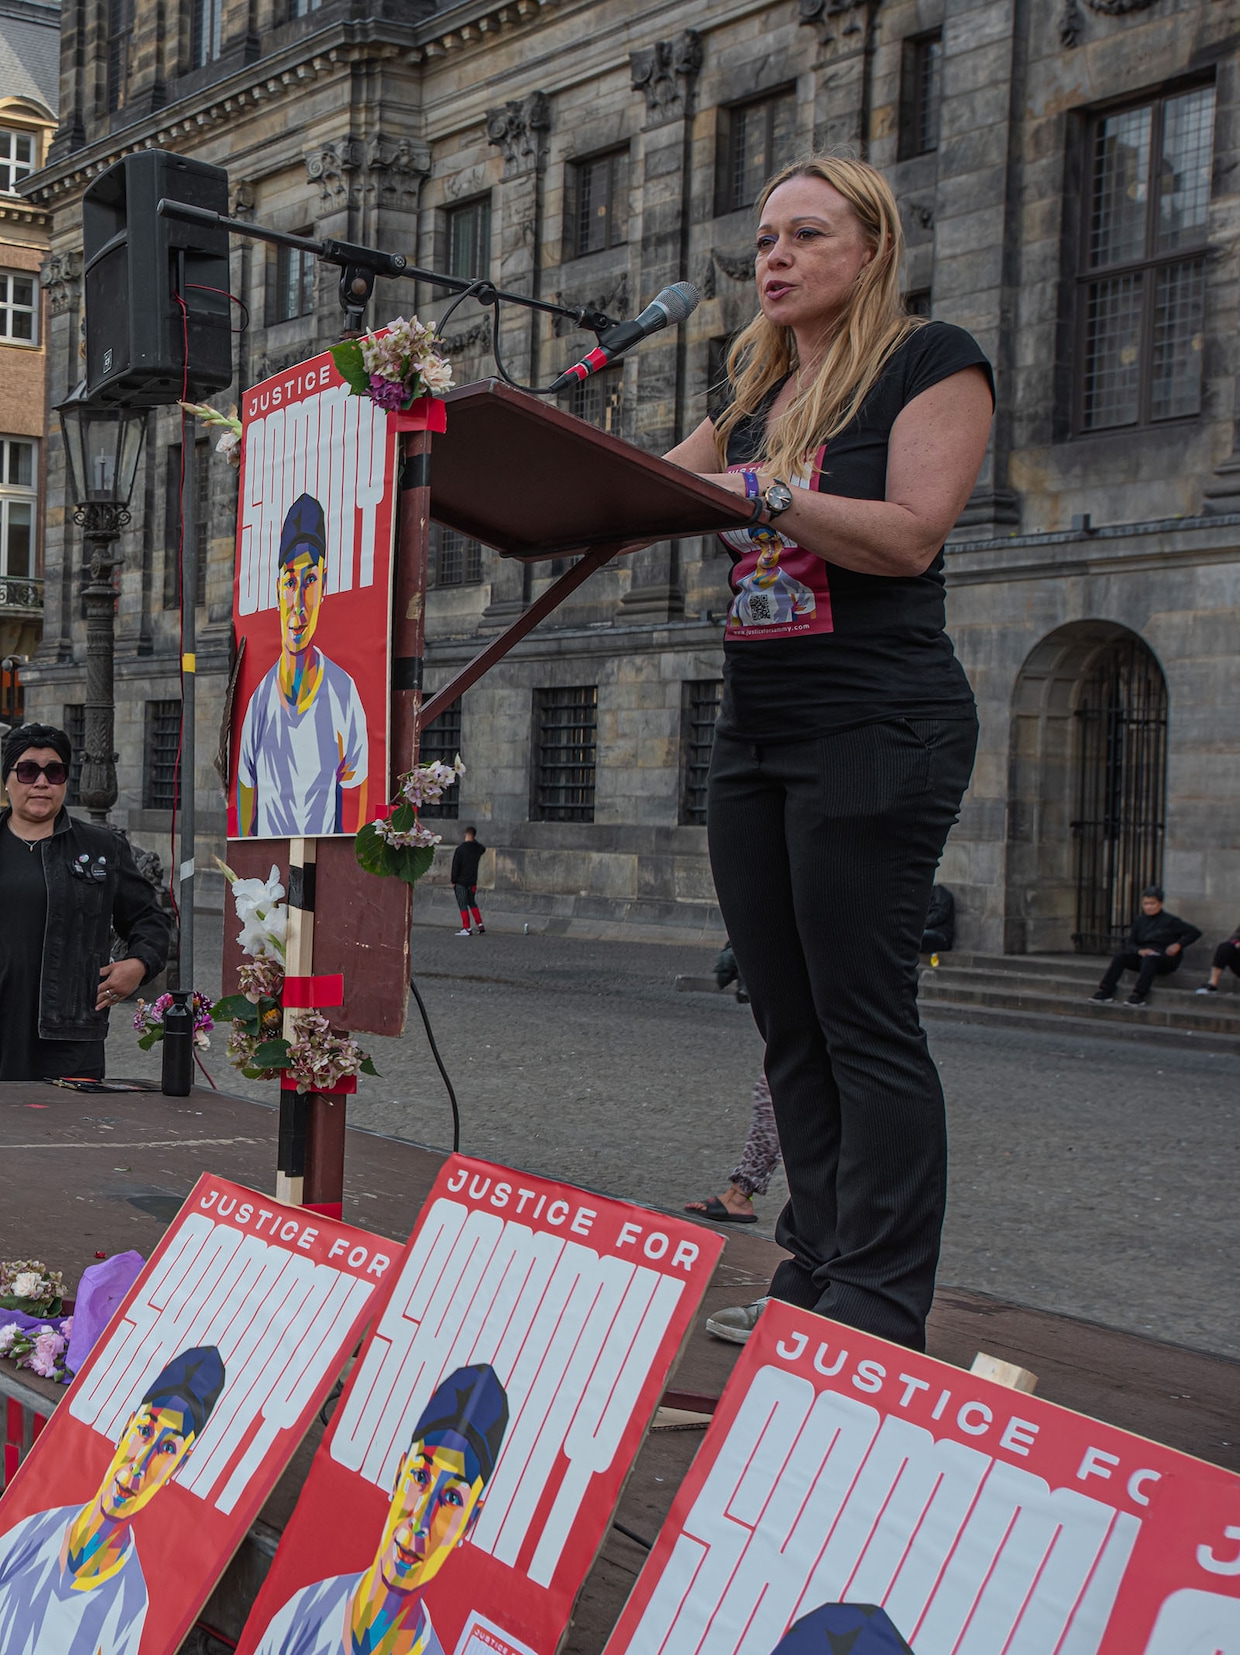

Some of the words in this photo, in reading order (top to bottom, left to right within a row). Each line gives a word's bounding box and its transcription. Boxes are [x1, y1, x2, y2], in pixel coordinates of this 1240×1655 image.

[248, 364, 331, 417] JUSTICE
[200, 1190, 319, 1250] JUSTICE
[328, 1238, 390, 1278] FOR
[447, 1169, 597, 1236] JUSTICE
[616, 1222, 700, 1271] FOR
[776, 1330, 1041, 1457] JUSTICE
